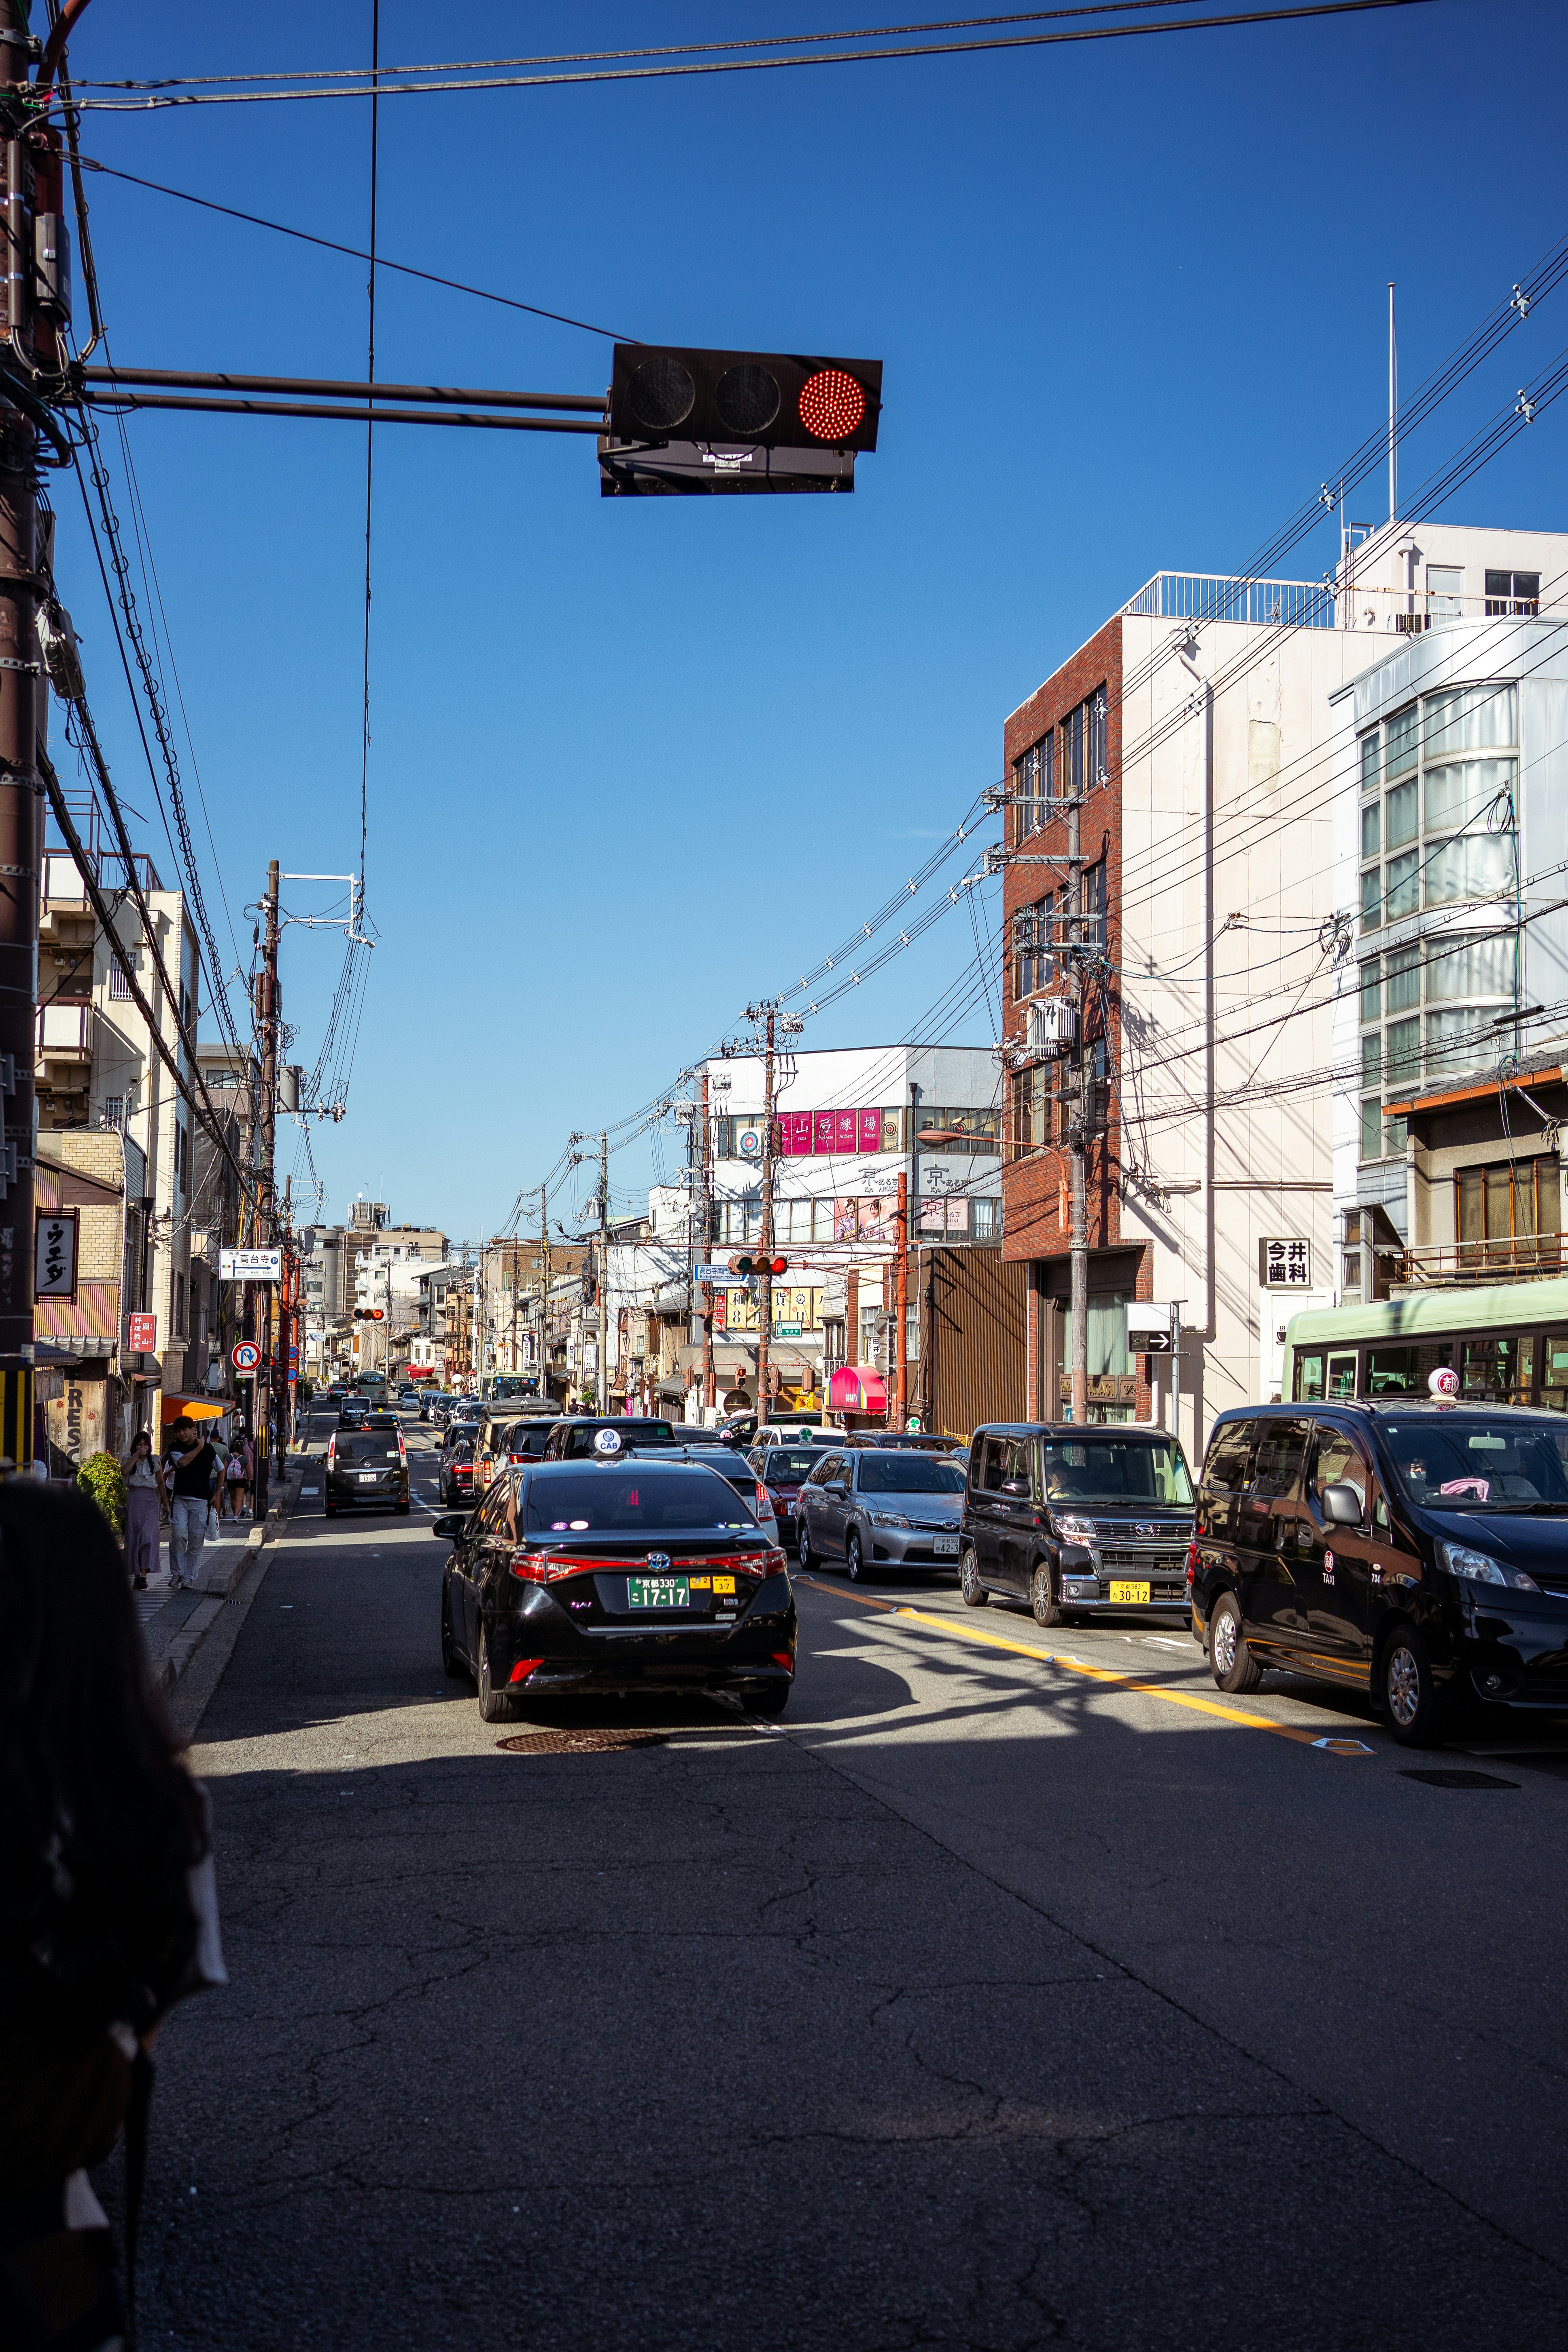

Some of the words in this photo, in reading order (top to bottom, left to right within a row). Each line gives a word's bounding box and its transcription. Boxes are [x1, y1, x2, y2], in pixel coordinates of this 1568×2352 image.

[42, 1223, 68, 1288] ウエダ
[240, 1254, 269, 1263] 高台寺
[1268, 1242, 1307, 1261] 今井
[1268, 1263, 1307, 1282] 歯科
[134, 1316, 142, 1349] 料理教室
[1087, 1381, 1114, 1397] AKAGI
[1442, 1376, 1456, 1391] 都
[642, 1579, 675, 1588] 京都330
[1322, 1573, 1335, 1585] TAXI
[1371, 1573, 1380, 1584] 734
[632, 1593, 639, 1602] こ
[643, 1588, 685, 1606] 17-17
[1119, 1590, 1147, 1601] 30-12
